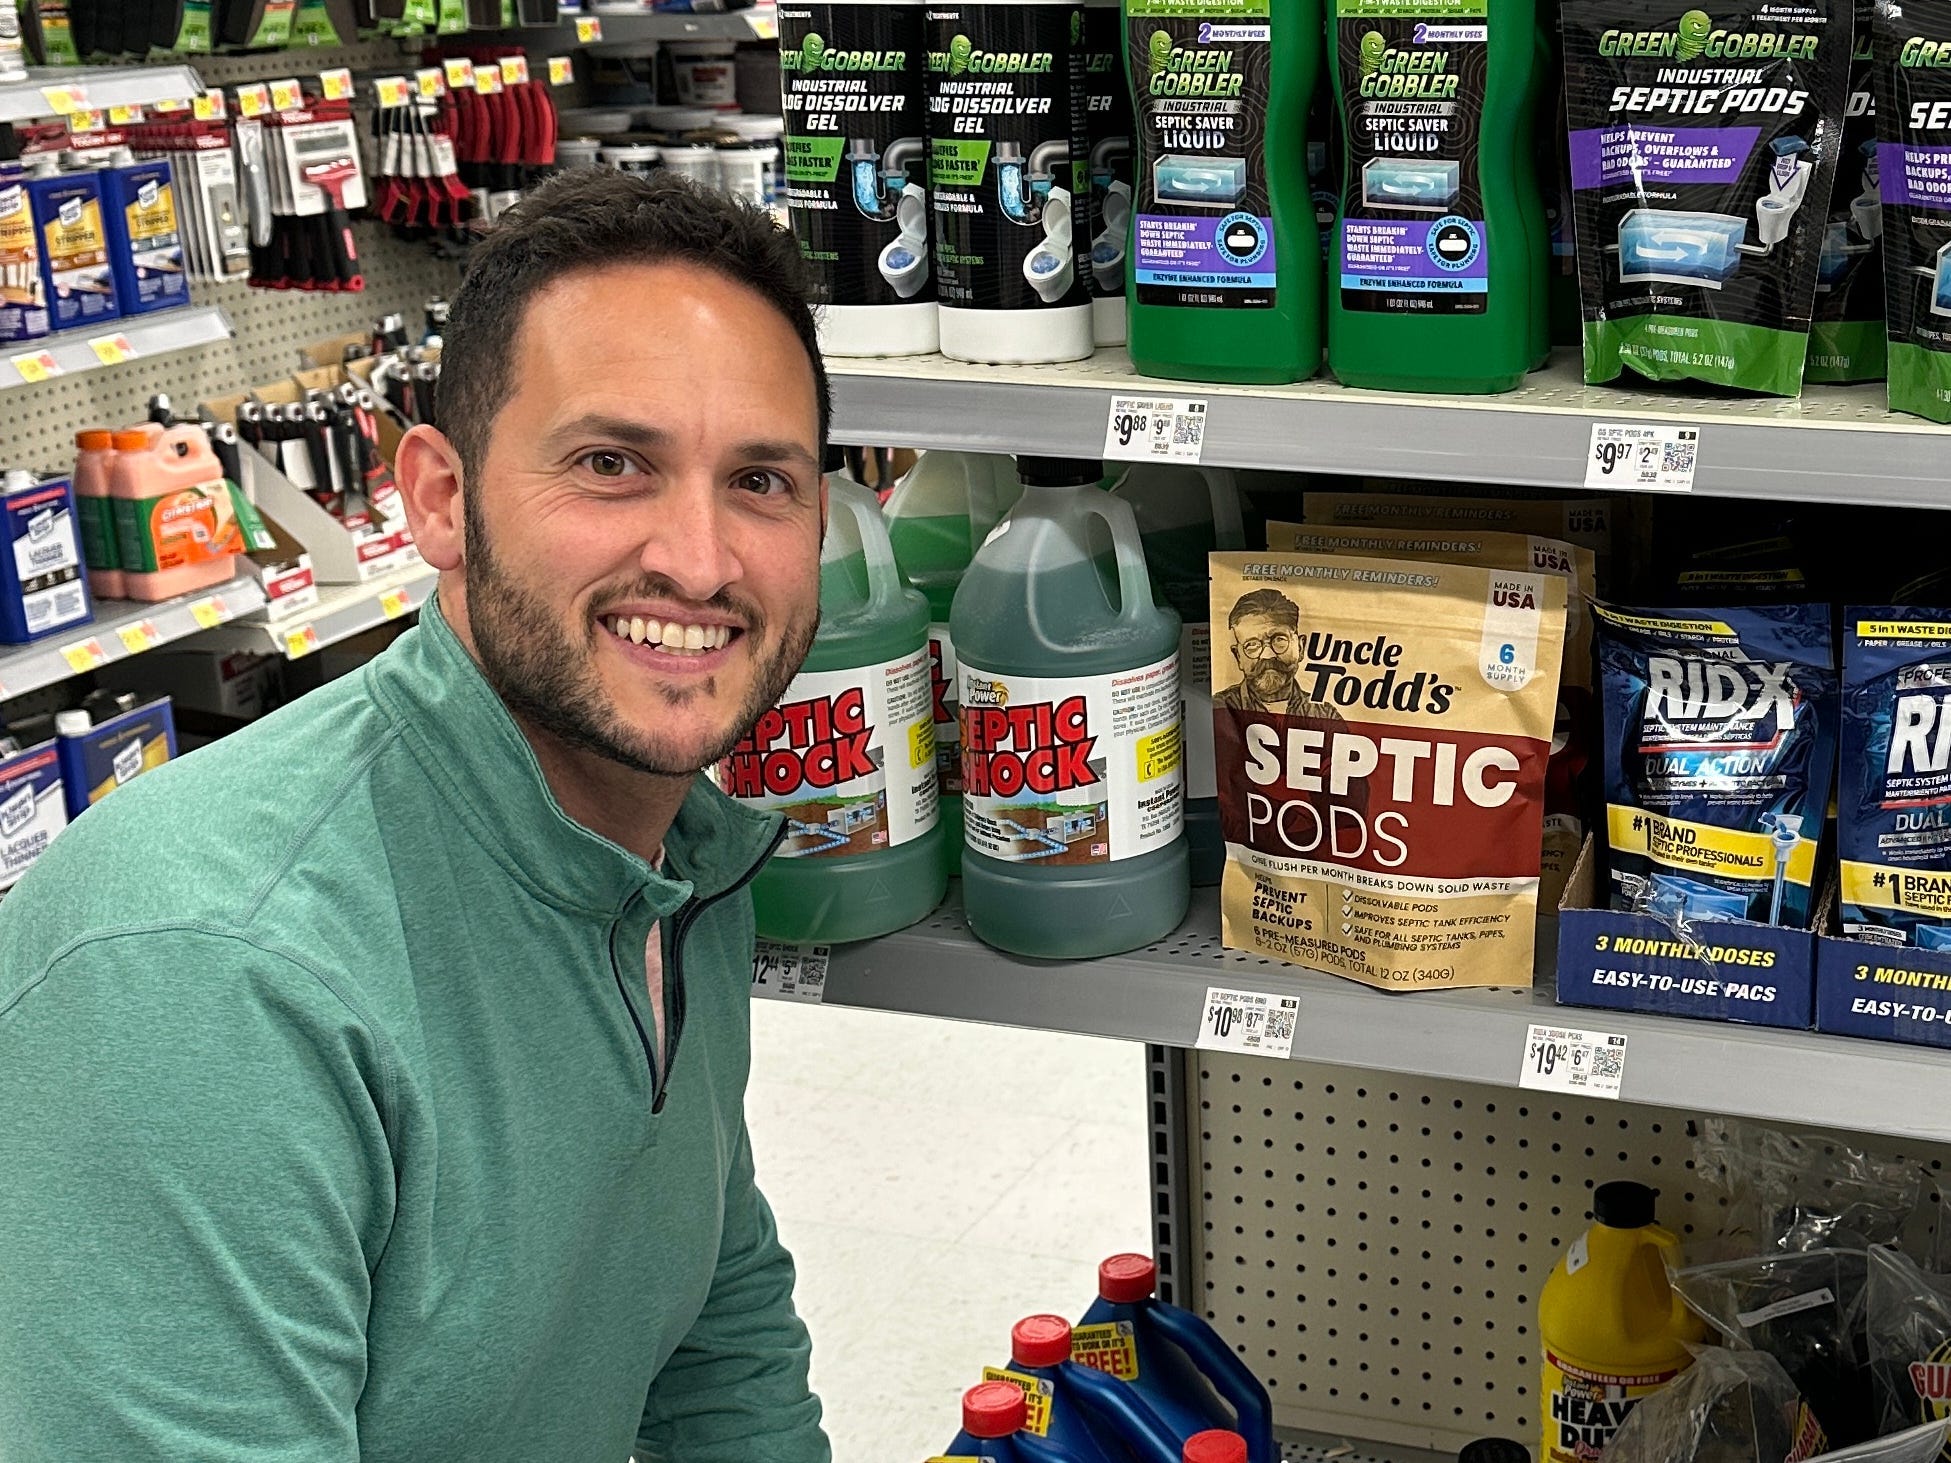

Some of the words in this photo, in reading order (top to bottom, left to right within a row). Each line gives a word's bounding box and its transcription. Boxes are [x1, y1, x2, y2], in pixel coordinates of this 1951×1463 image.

[1198, 23, 1211, 43] 2
[1413, 23, 1427, 43] 2
[1599, 30, 1678, 57] GREEN
[1705, 30, 1819, 60] GOBBLER
[821, 48, 906, 71] GOBBLER
[968, 50, 1053, 73] GOBBLER
[1167, 47, 1233, 73] GREEN
[1380, 48, 1449, 74] GREEN
[1149, 70, 1244, 97] GOBBLER
[1360, 72, 1459, 98] GOBBLER
[1656, 68, 1763, 84] INDUSTRIAL
[792, 80, 868, 93] INDUSTRIAL
[940, 82, 1014, 95] INDUSTRIAL
[782, 94, 803, 111] LOG
[805, 95, 905, 111] DISSOLVER
[930, 96, 950, 113] LOG
[952, 98, 1051, 114] DISSOLVER
[1163, 101, 1228, 112] INDUSTRIAL
[1375, 103, 1442, 114] INDUSTRIAL
[1609, 87, 1720, 114] SEPTIC
[1720, 88, 1809, 115] PODS
[806, 114, 839, 130] GEL
[954, 117, 984, 133] GEL
[1155, 116, 1192, 129] SEPTIC
[1195, 117, 1234, 130] SAVER
[1366, 118, 1405, 131] SEPTIC
[1408, 119, 1449, 132] SAVER
[1164, 130, 1225, 149] LIQUID
[1374, 133, 1439, 152] LIQUID
[1600, 132, 1625, 144] HELPS
[1645, 146, 1709, 157] OVERFLOWS
[1710, 146, 1719, 156] &
[1905, 151, 1930, 164] HELPS
[1602, 159, 1616, 171] BAD
[1907, 179, 1924, 191] BAD
[1568, 519, 1608, 533] USA
[1295, 535, 1328, 548] FREE
[1328, 535, 1395, 550] MONTHLY
[1397, 538, 1482, 554] REMINDERS!
[1534, 553, 1573, 574] USA
[1243, 562, 1280, 576] FREE
[1281, 563, 1350, 580] MONTHLY
[1353, 569, 1440, 588] REMINDERS!
[1494, 582, 1521, 592] MADE
[1523, 584, 1534, 593] IN
[1492, 591, 1535, 610] USA
[1661, 620, 1713, 631] DIGESTION
[1870, 625, 1877, 633] 5
[1878, 625, 1889, 633] in
[1897, 625, 1935, 635] WASTE
[1307, 632, 1403, 667] Uncle
[1864, 640, 1888, 648] PAPER
[1500, 644, 1515, 664] 6
[1487, 664, 1526, 675] MONTH
[1487, 672, 1526, 684] SUPPLY
[969, 689, 1003, 704] Power
[1304, 663, 1455, 715] Todd's
[1245, 723, 1520, 808] SEPTIC
[1646, 757, 1690, 776] DUAL
[1697, 756, 1765, 776] ACTION
[1887, 778, 1915, 788] SEPTIC
[1917, 776, 1945, 787] SYSTEM
[1247, 792, 1409, 867] PODS
[1896, 810, 1949, 831] DUAL
[1654, 820, 1696, 844] BRAND
[1676, 844, 1764, 867] PROFESSIONALS
[1269, 858, 1298, 872] FLUSH
[1301, 864, 1319, 875] PER
[1322, 867, 1354, 881] MONTH
[1357, 875, 1393, 890] BREAKS
[1398, 881, 1434, 893] DOWN
[1438, 882, 1470, 893] SOLID
[1472, 881, 1511, 891] WASTE
[1255, 882, 1307, 903] PREVENT
[1905, 892, 1945, 906] SEPTIC
[1252, 896, 1293, 914] SEPTIC
[1354, 894, 1409, 912] DISSOLVABLE
[1412, 902, 1439, 913] PODS
[1252, 909, 1312, 930] BACKUPS
[1398, 916, 1429, 928] SEPTIC
[1433, 917, 1457, 927] TANK
[1354, 925, 1373, 936] SAFE
[1374, 929, 1391, 940] FOR
[1393, 932, 1408, 942] ALL
[1411, 932, 1443, 943] SEPTIC
[1262, 928, 1339, 953] PRE-MEASURED
[1340, 945, 1366, 961] PODS
[1420, 941, 1461, 952] SYSTEMS
[1595, 936, 1608, 951] 3
[1613, 937, 1706, 960] MONTHLY
[1709, 946, 1776, 968] DOSES
[1274, 942, 1287, 953] OZ
[1350, 960, 1378, 976] TOTAL
[1380, 968, 1389, 979] 12
[1392, 970, 1409, 981] OZ
[1413, 966, 1455, 981] (340G)
[1855, 966, 1869, 981] 3
[1592, 968, 1718, 996] EASY-TO-USE
[1725, 982, 1777, 1002] PACS
[1552, 1393, 1644, 1427] HEAV
